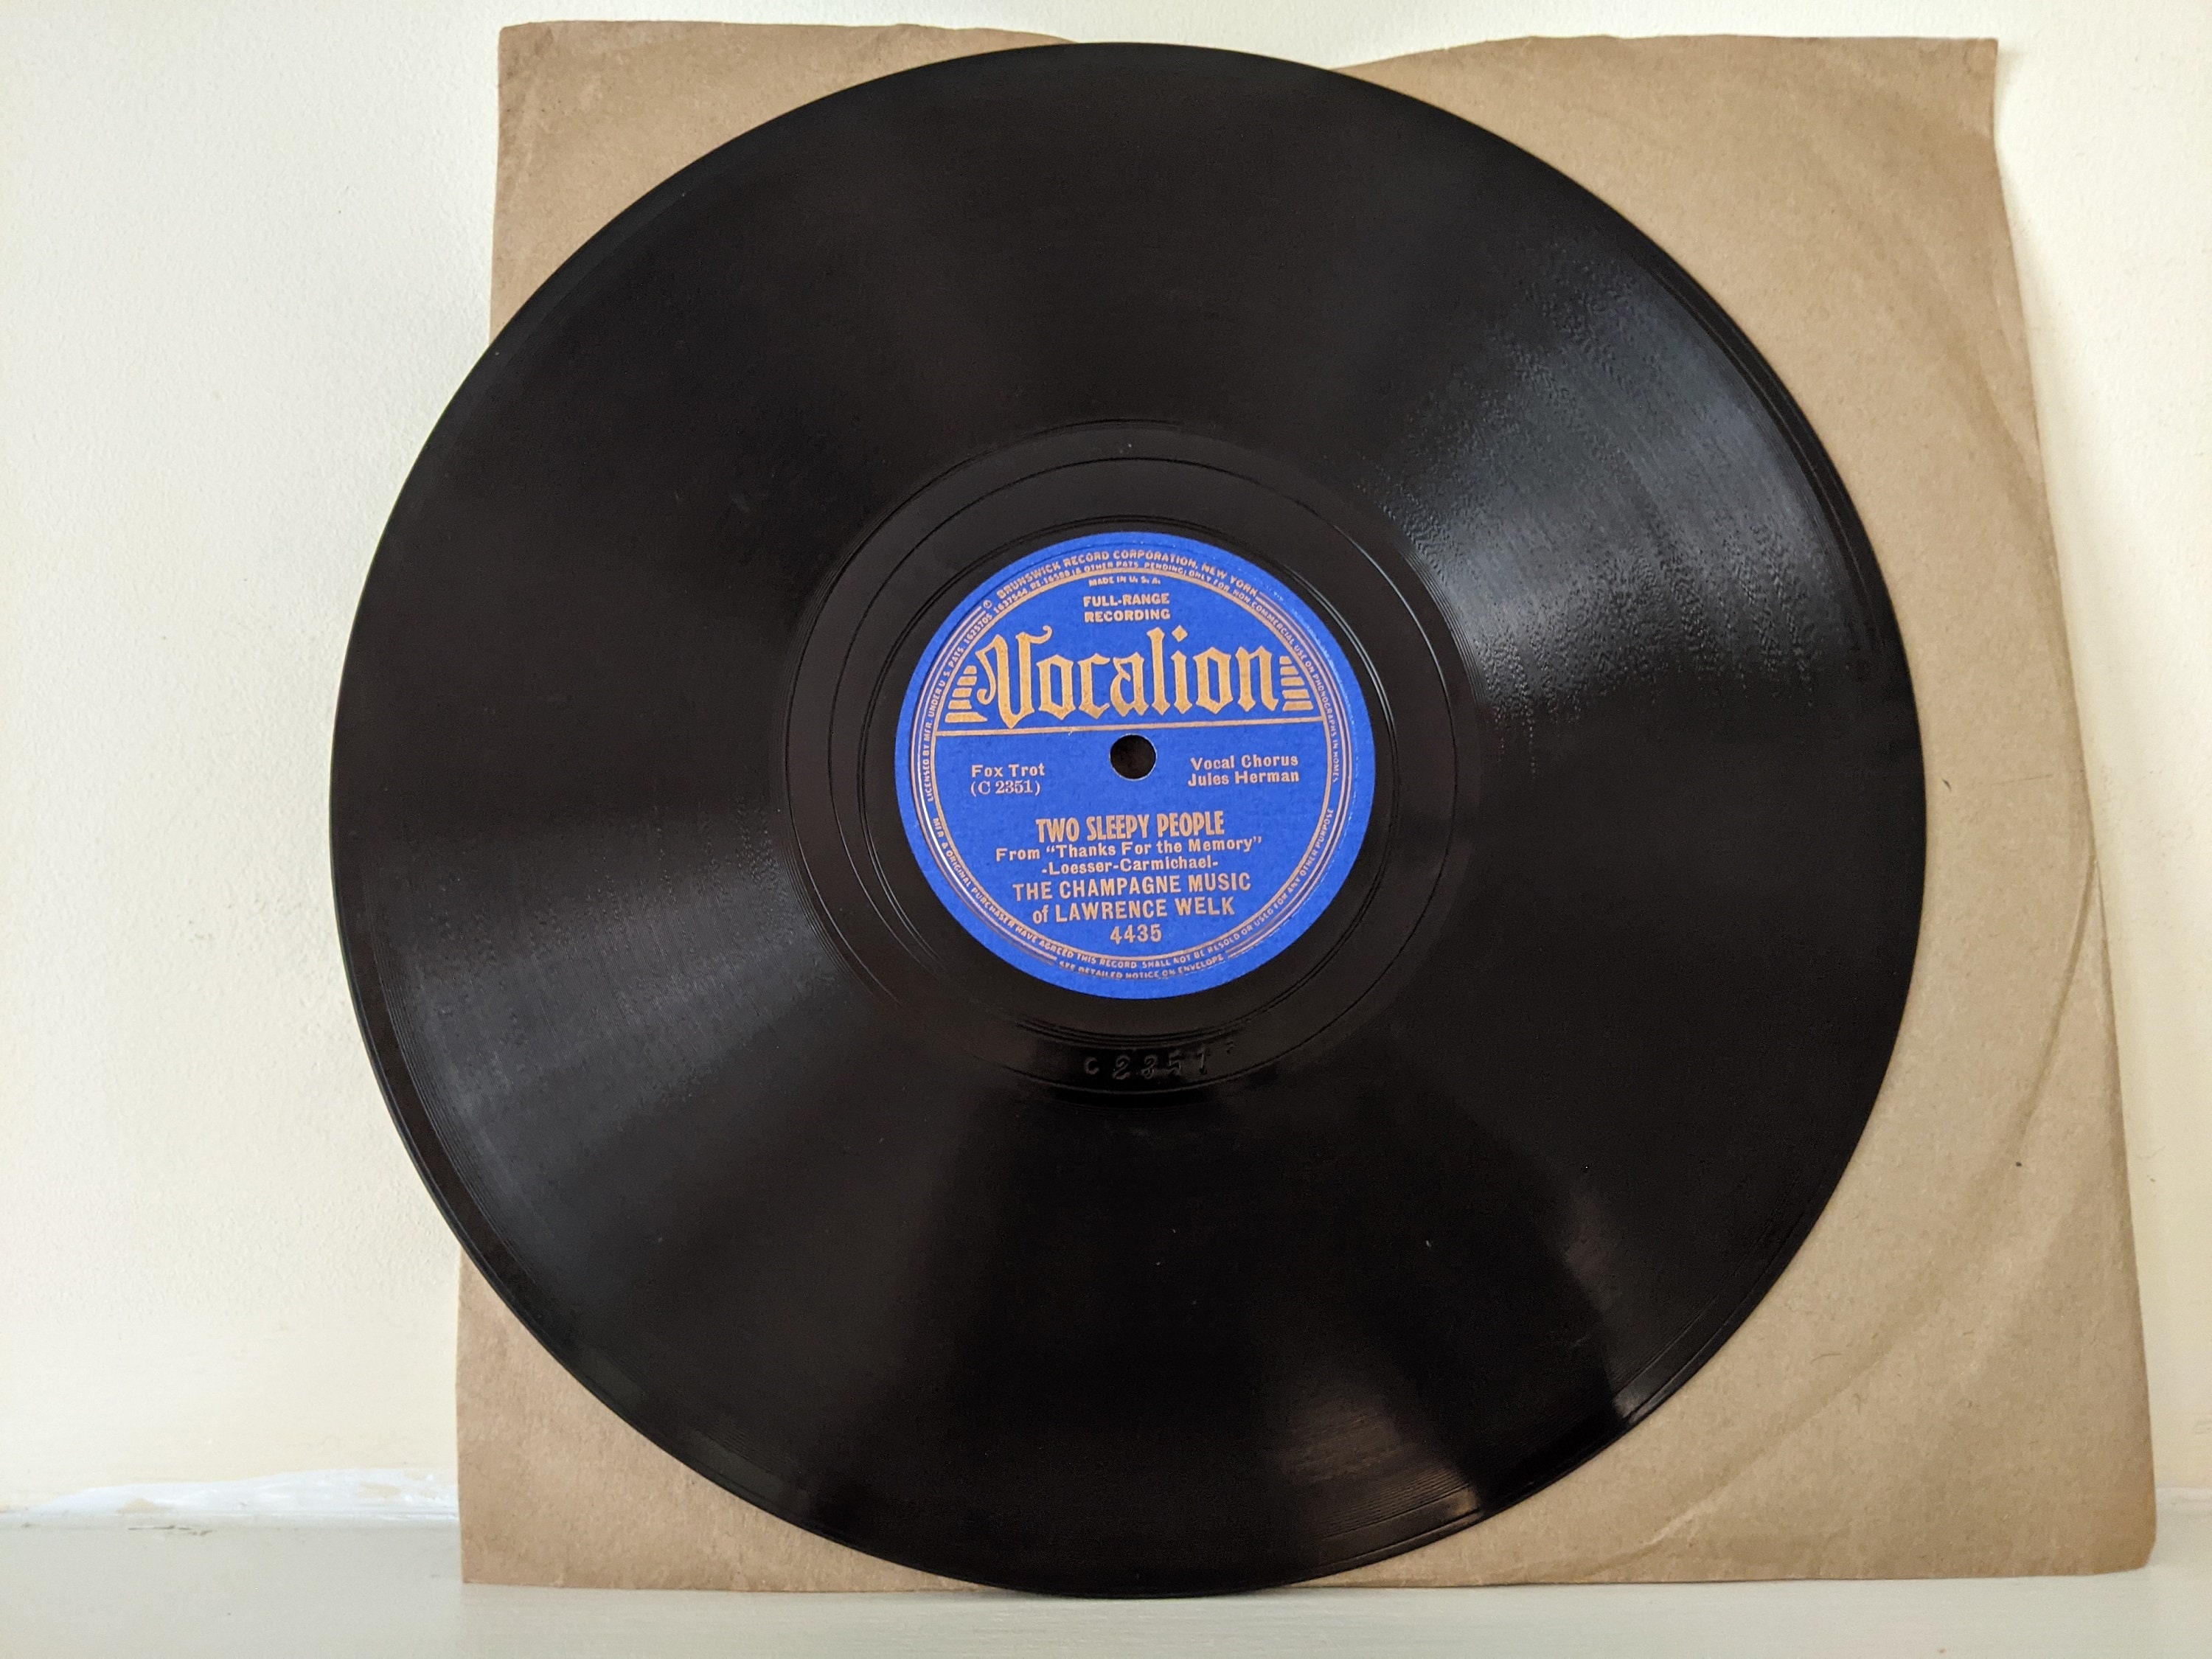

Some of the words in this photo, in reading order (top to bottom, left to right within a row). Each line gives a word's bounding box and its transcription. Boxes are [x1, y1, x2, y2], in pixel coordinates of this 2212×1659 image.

[997, 562, 1060, 599] BRUNSWICK
[1063, 552, 1109, 568] RECORD
[1113, 550, 1197, 569] CORPORATION,
[1202, 563, 1227, 580] NEW
[1230, 577, 1258, 597] YORK
[1084, 562, 1113, 573] OTHER
[1189, 569, 1211, 583] ONLY
[1088, 576, 1114, 587] MADE
[1212, 580, 1230, 592] FOR
[1083, 593, 1170, 608] FULL-RANGE
[1084, 609, 1171, 623] RECORDING
[963, 613, 992, 644] 1625705
[1293, 646, 1307, 661] USE
[1304, 661, 1315, 673] ON
[975, 625, 1279, 729] Vocalion
[928, 687, 942, 717] UNDER
[1311, 674, 1338, 736] PHONOGRAPHS
[922, 745, 931, 756] BY
[1332, 740, 1338, 748] IN
[971, 765, 1004, 778] Fox
[1008, 762, 1046, 777] Trot
[1190, 755, 1235, 771] Vocal
[1241, 754, 1298, 768] Chorus
[922, 759, 933, 802] LICENSED
[970, 781, 991, 797] (C
[995, 779, 1040, 796] 2351)
[1188, 773, 1230, 787] Jules
[1234, 771, 1300, 785] Herman
[1035, 817, 1080, 843] TWO
[1086, 814, 1150, 841] SLEEPY
[1156, 810, 1225, 838] PEOPLE
[996, 848, 1040, 862] From
[1121, 841, 1152, 855] For
[1156, 840, 1183, 854] the
[945, 849, 972, 888] ORIGINAL
[972, 886, 1015, 928] PURCHASER
[1015, 925, 1038, 943] HAVE
[1040, 938, 1074, 959] AGREED
[1077, 953, 1096, 964] THIS
[1100, 957, 1136, 968] RECORD
[1141, 959, 1170, 968] SHALL
[1174, 954, 1190, 963] NOT
[1193, 950, 1205, 959] BE
[1208, 932, 1240, 953] RESOLD
[1240, 925, 1253, 935] OR
[1252, 908, 1274, 926] USED
[1273, 892, 1287, 908] FOR
[1287, 877, 1301, 894] ANY
[1299, 849, 1318, 876] OTHER
[1315, 808, 1333, 848] PURPOSE
[1012, 881, 1052, 901] THE
[1059, 875, 1181, 900] CHAMPAGNE
[1188, 872, 1251, 893] MUSIC
[1032, 905, 1049, 925] of
[1056, 898, 1168, 923] LAWRENCE
[1175, 896, 1236, 917] WELK
[1110, 924, 1162, 945] 4435
[1059, 961, 1075, 970] SEE
[1078, 966, 1122, 978] DETAILED
[1178, 954, 1224, 973] ENVELOPE
